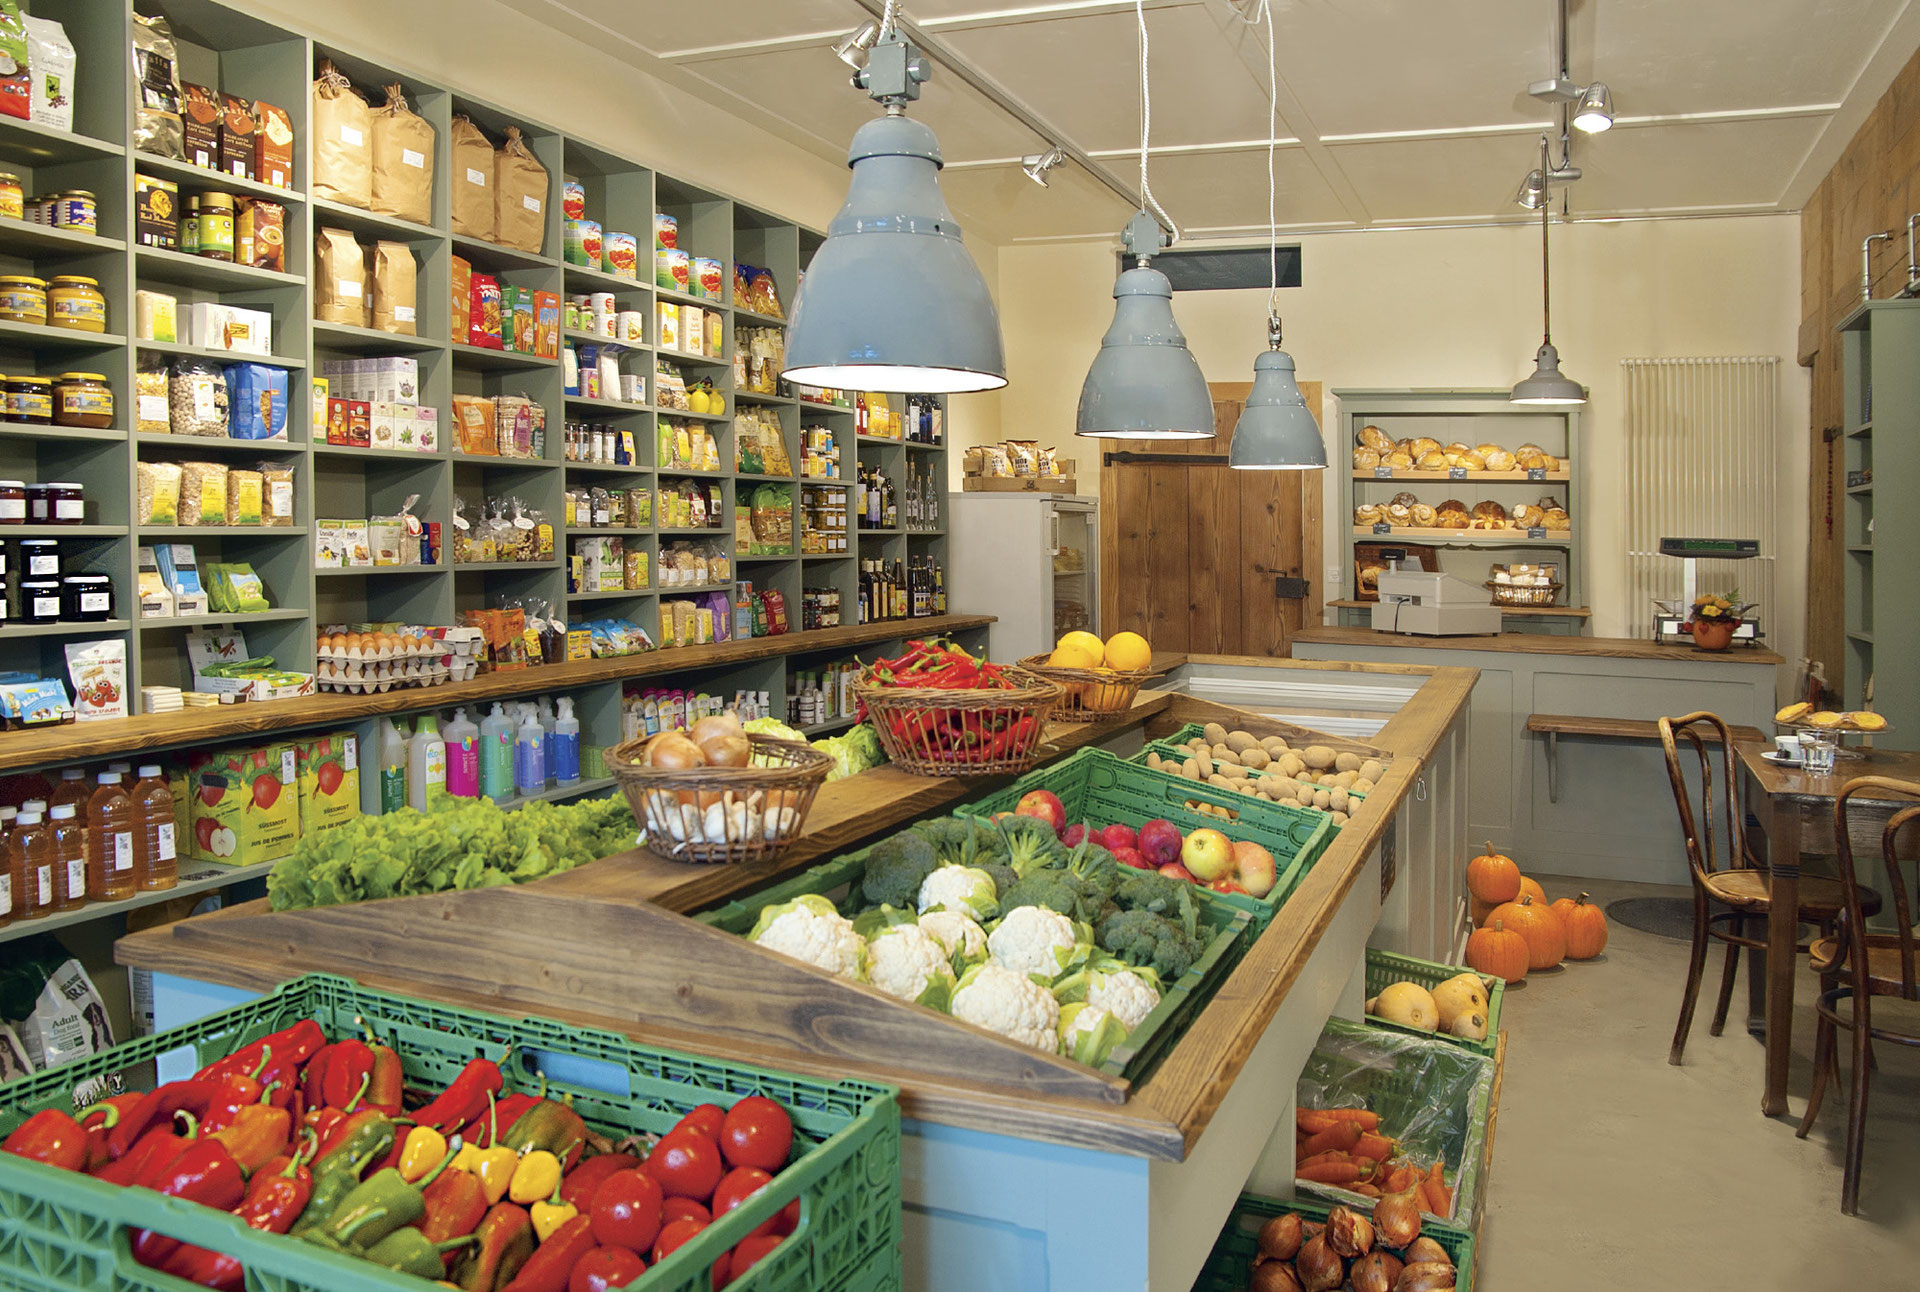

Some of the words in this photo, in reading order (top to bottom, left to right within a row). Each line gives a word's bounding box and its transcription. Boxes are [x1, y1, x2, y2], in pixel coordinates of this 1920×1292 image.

[258, 818, 287, 830] SÜSSMOST
[250, 838, 262, 847] JUS
[271, 832, 294, 843] POMMES
[52, 1014, 79, 1029] Adult
